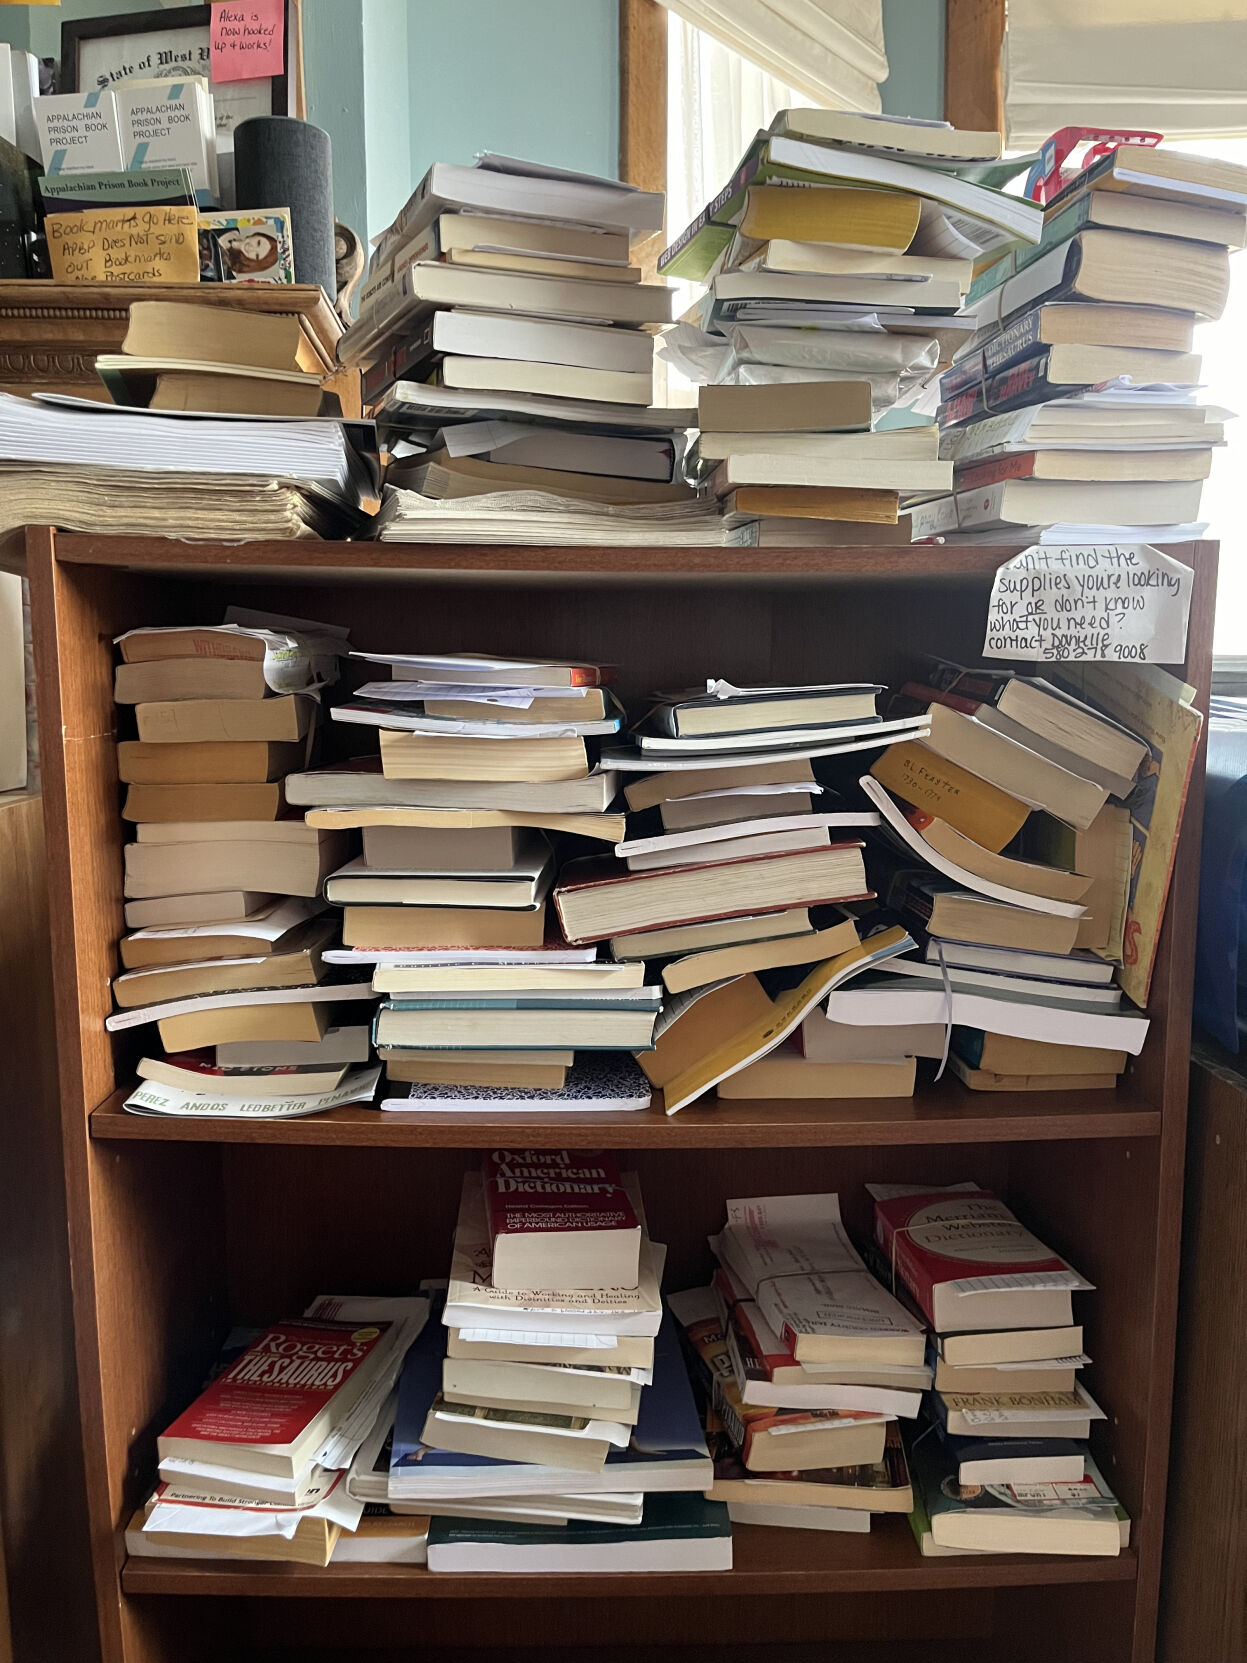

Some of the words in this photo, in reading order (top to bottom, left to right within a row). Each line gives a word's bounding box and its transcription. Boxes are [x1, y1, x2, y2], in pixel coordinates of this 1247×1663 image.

[220, 9, 244, 22] Alexa
[250, 12, 260, 22] is
[220, 26, 240, 36] now
[244, 23, 276, 36] hooked
[214, 40, 226, 53] up
[240, 38, 272, 52] works!
[96, 64, 134, 89] State
[138, 54, 153, 70] of
[156, 49, 193, 66] West
[130, 103, 185, 116] APPALACHIAN
[46, 112, 102, 124] APPALACHIAN
[132, 117, 162, 128] PRISON
[167, 114, 191, 124] BOOK
[48, 124, 80, 135] PRISON
[84, 122, 110, 132] BOOK
[133, 127, 172, 139] PROJECT
[49, 135, 90, 147] PROJECT
[44, 181, 97, 196] Appalachian
[98, 180, 126, 191] Prison
[128, 177, 150, 188] Book
[150, 178, 181, 192] Project
[660, 250, 671, 267] WEB
[672, 234, 691, 256] DESIGN
[691, 224, 698, 236] IN
[714, 183, 732, 212] STEPS
[62, 242, 96, 257] APBP
[988, 316, 1034, 356] DICTIONARY
[988, 332, 1034, 368] THESAURUS
[1005, 550, 1053, 572] an't
[1055, 548, 1099, 568] find
[1101, 546, 1140, 568] the
[998, 572, 1071, 600] supplies
[1126, 567, 1181, 597] looking
[992, 598, 1018, 616] for
[1054, 594, 1099, 614] don't
[1104, 596, 1146, 612] know
[990, 614, 1032, 633] what
[1032, 616, 1062, 637] you
[988, 634, 1046, 650] contact
[1042, 646, 1070, 660] 580
[1072, 645, 1110, 659] 278
[1113, 642, 1149, 660] 9008
[132, 1090, 170, 1107] PEREZ
[239, 1100, 306, 1112] LEDBETTER
[492, 1150, 571, 1165] Oxford
[496, 1164, 607, 1178] American
[497, 1176, 616, 1198] Dictionary
[968, 1203, 999, 1211] The
[507, 1222, 524, 1230] OF
[924, 1228, 1025, 1244] Dictionary
[530, 1290, 575, 1300] Working
[600, 1292, 640, 1300] Healing
[253, 1333, 368, 1361] Roget's
[228, 1355, 354, 1386] THESAURUS
[952, 1396, 1002, 1408] FRANK
[1008, 1394, 1085, 1407] BONHAM
[170, 1492, 208, 1502] Partnering
[218, 1496, 237, 1504] Build
